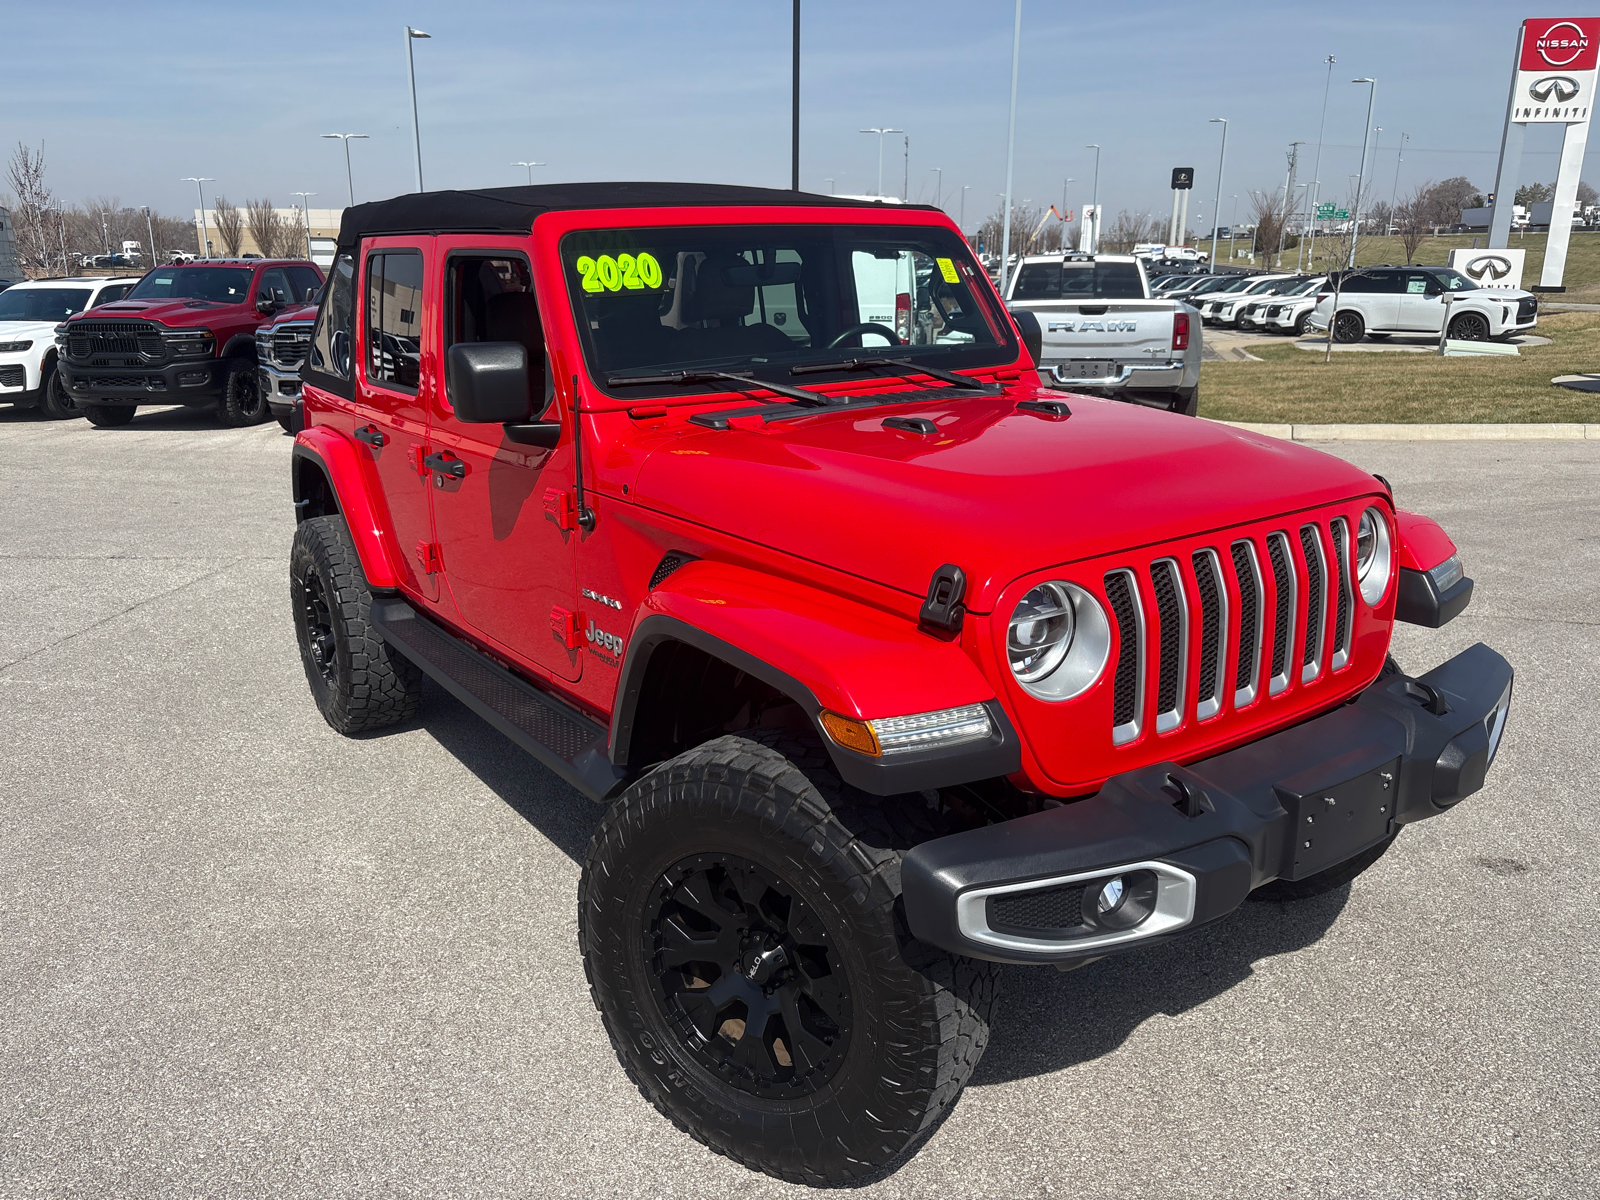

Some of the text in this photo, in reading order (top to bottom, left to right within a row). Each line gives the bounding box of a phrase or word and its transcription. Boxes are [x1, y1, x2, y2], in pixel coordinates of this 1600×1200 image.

[1515, 107, 1587, 118] INFINITI
[577, 252, 663, 293] 2020
[1048, 320, 1138, 332] RAM
[582, 587, 622, 610] SAHARA
[585, 620, 623, 657] Jeep
[746, 956, 761, 980] HELO
